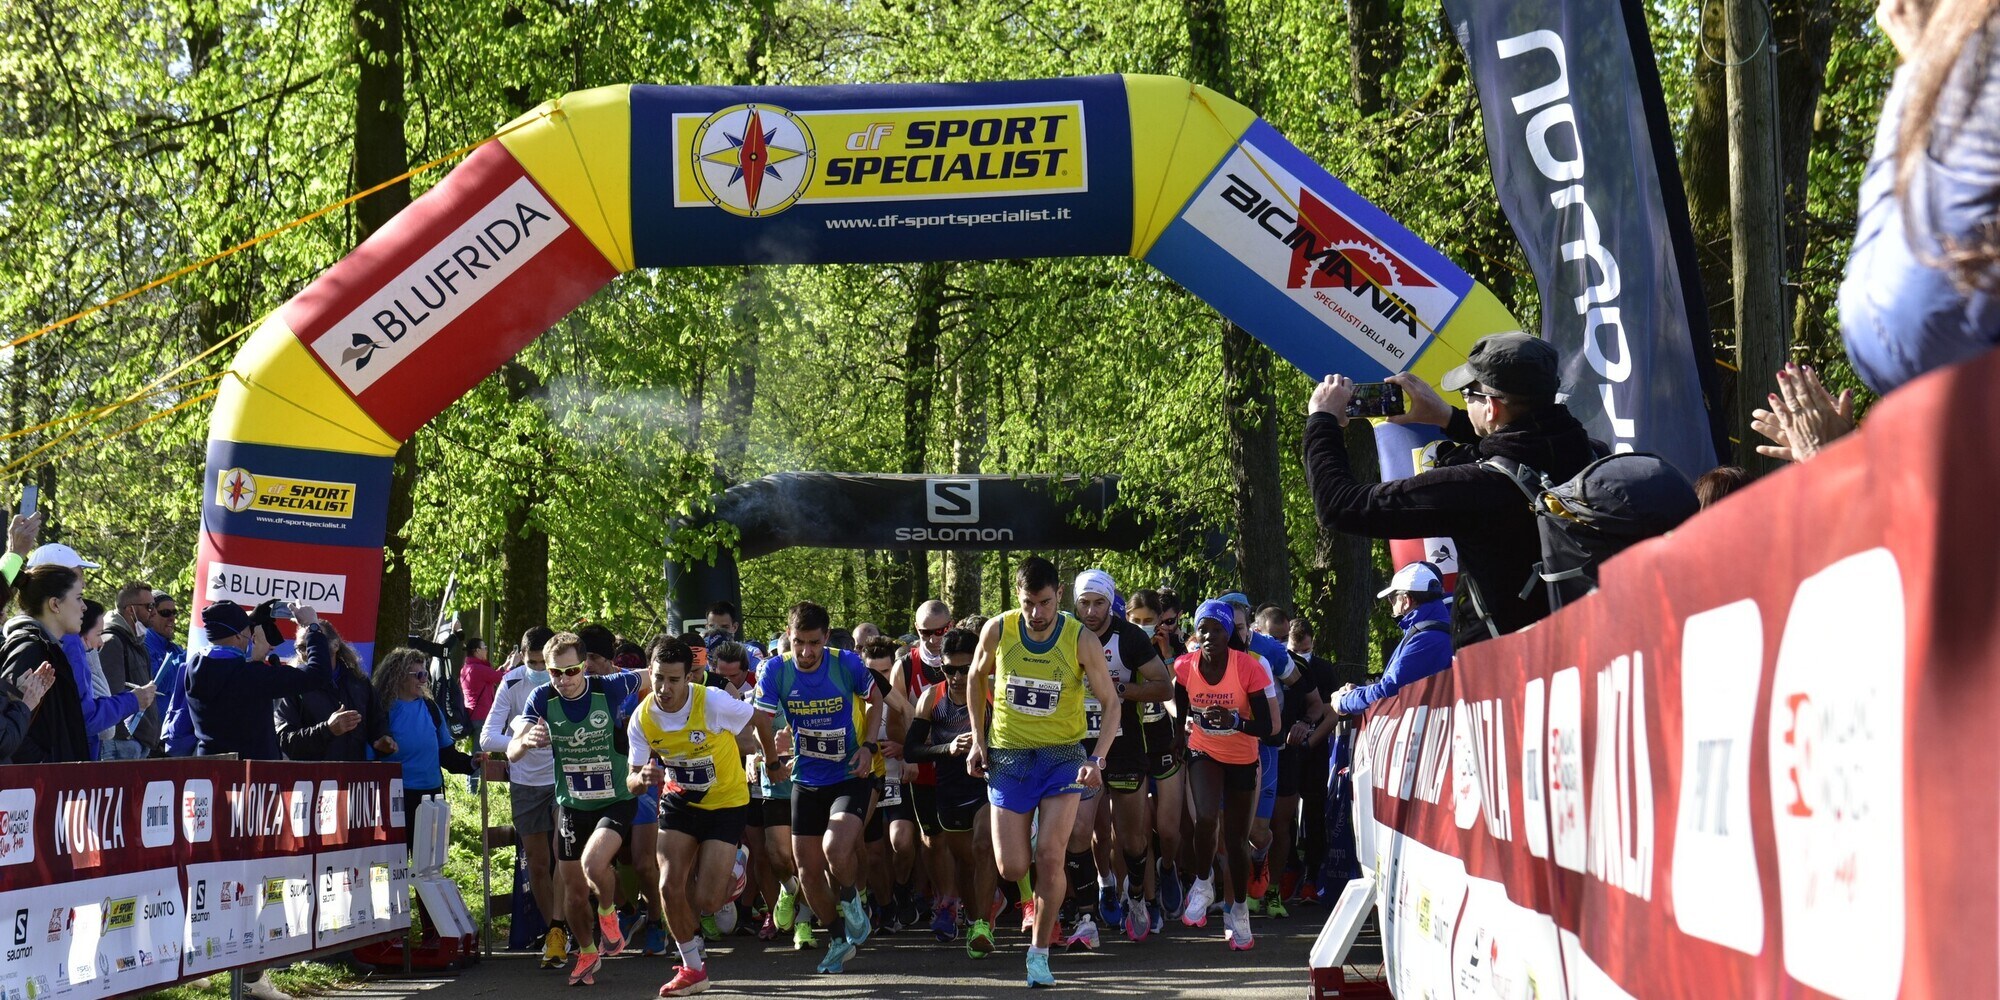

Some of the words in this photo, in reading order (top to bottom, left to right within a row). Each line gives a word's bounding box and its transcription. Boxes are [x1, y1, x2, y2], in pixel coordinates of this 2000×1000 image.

[904, 114, 1068, 149] SPORT
[825, 149, 1062, 186] SPECIALIST
[825, 207, 1071, 230] www.df-sportspecialist.it
[372, 201, 550, 343] BLUFRIDA
[1313, 290, 1361, 328] SPECIALISTI
[1360, 325, 1387, 349] DELLA
[1386, 343, 1405, 360] BICI
[290, 485, 351, 500] SPORT
[258, 494, 348, 513] SPECIALIST
[256, 515, 347, 530] www.df-sportspecialist.it
[895, 527, 1014, 541] salomon
[231, 574, 340, 602] BLUFRIDA
[787, 696, 843, 708] ATLETICA
[1026, 692, 1037, 706] 3
[788, 704, 843, 715] PARATICO
[817, 741, 827, 752] 6
[584, 776, 592, 789] 1
[685, 771, 695, 782] 7
[230, 783, 284, 838] MONZA
[347, 781, 383, 829] MONZA
[10, 809, 29, 821] MILANO
[55, 787, 125, 855] MONZA
[9, 823, 26, 834] MONZA
[393, 868, 408, 881] SUUNT
[118, 902, 135, 914] SPORT
[144, 901, 175, 920] SUUNTO
[190, 911, 210, 923] salomon
[7, 946, 33, 961] salomon
